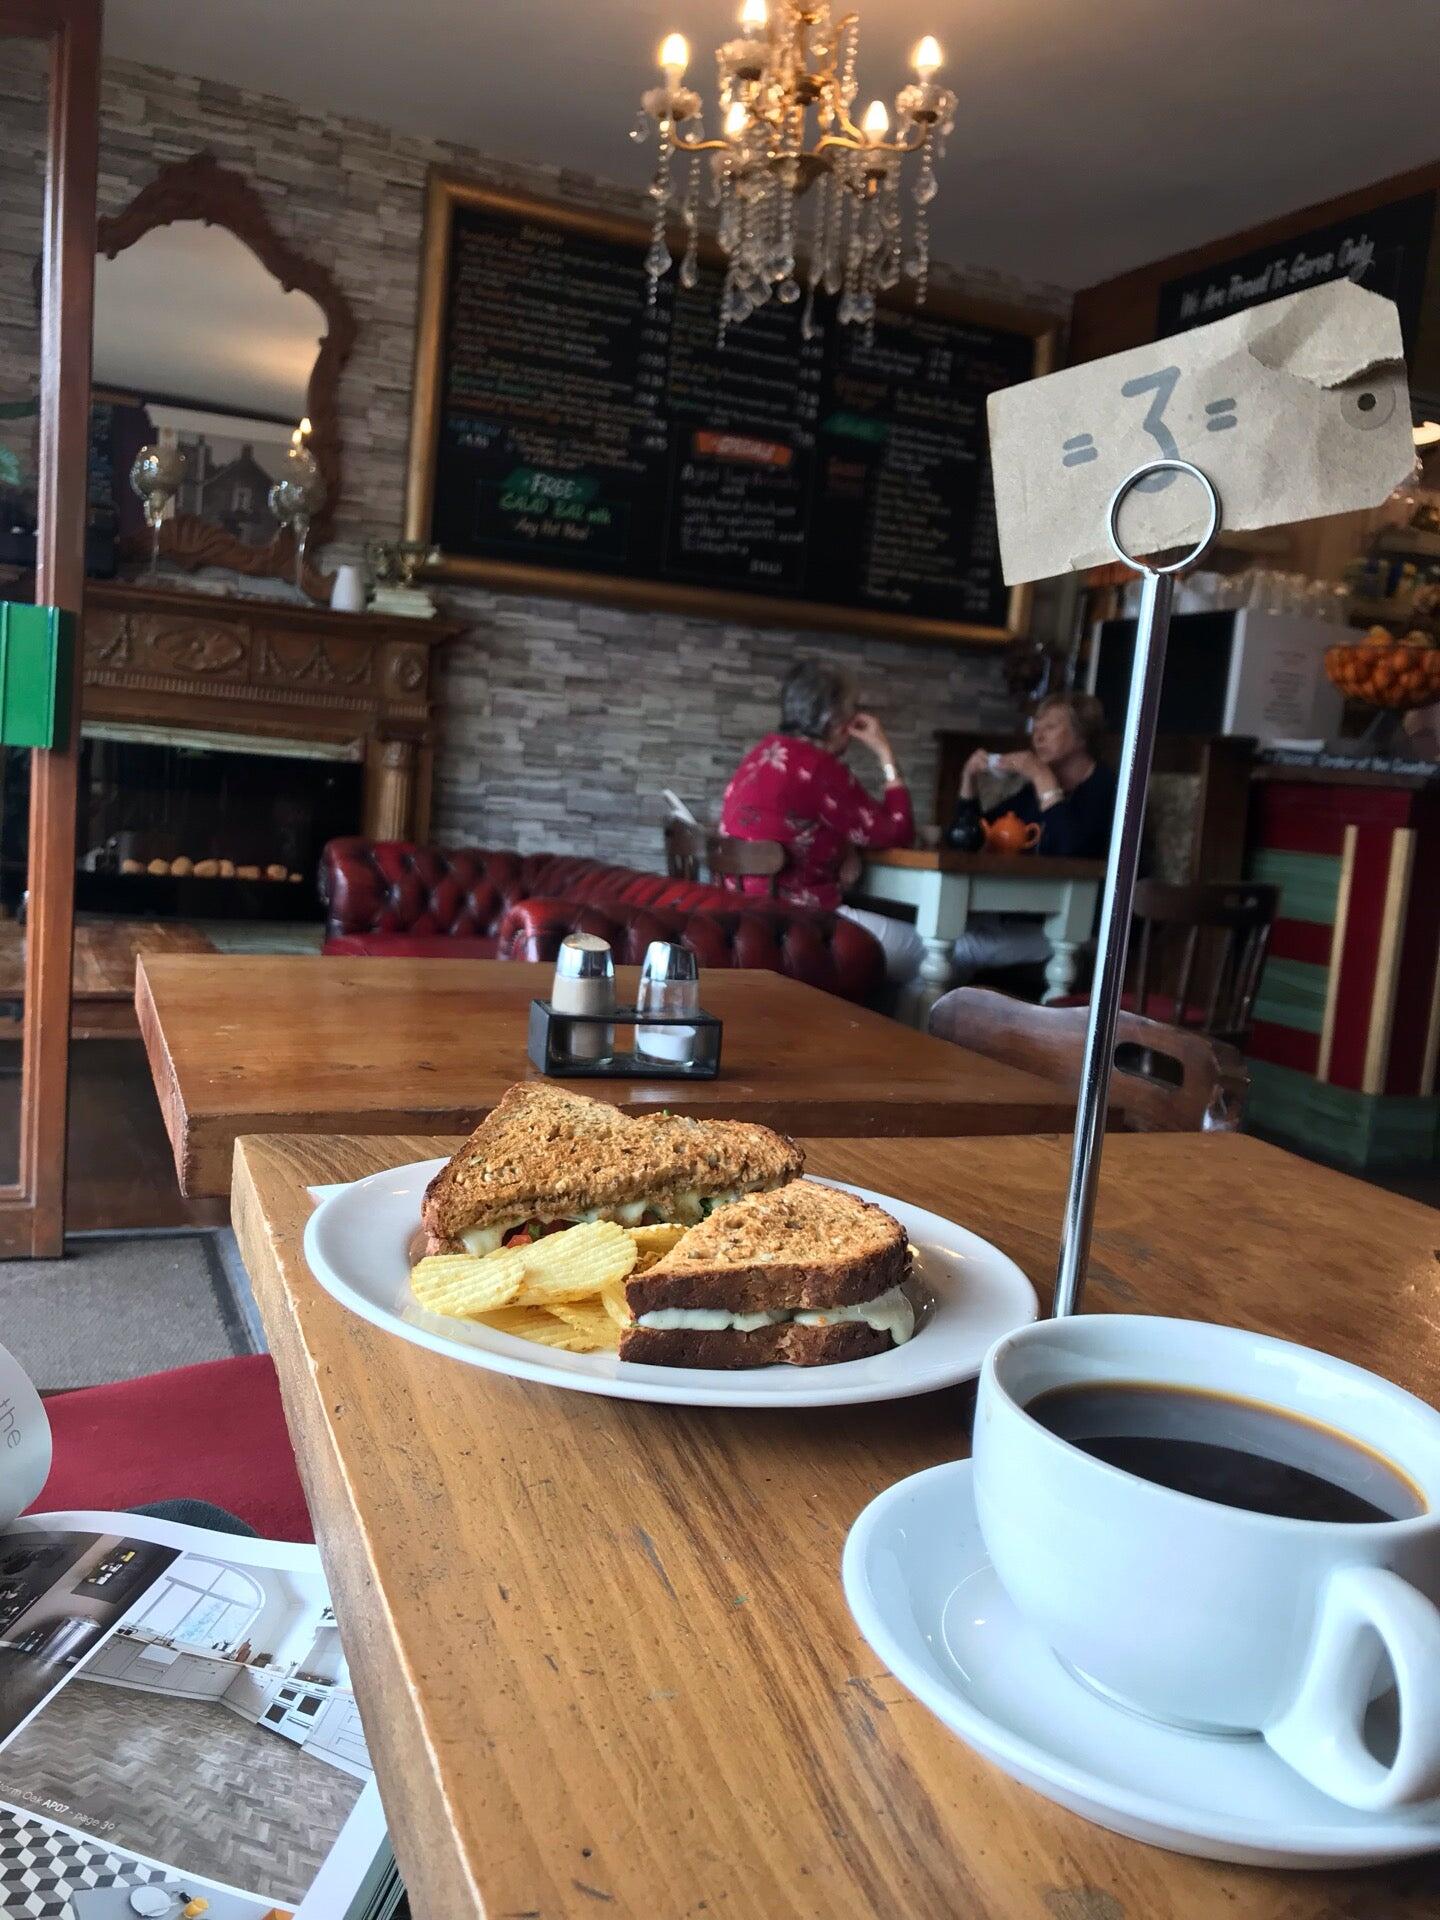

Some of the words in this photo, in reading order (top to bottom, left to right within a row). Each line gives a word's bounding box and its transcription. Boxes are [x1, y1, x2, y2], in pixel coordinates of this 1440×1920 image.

[0, 1398, 21, 1448] the
[22, 1791, 43, 1804] Oak
[42, 1799, 70, 1814] AP07
[73, 1812, 100, 1827] page
[100, 1821, 116, 1830] 39
